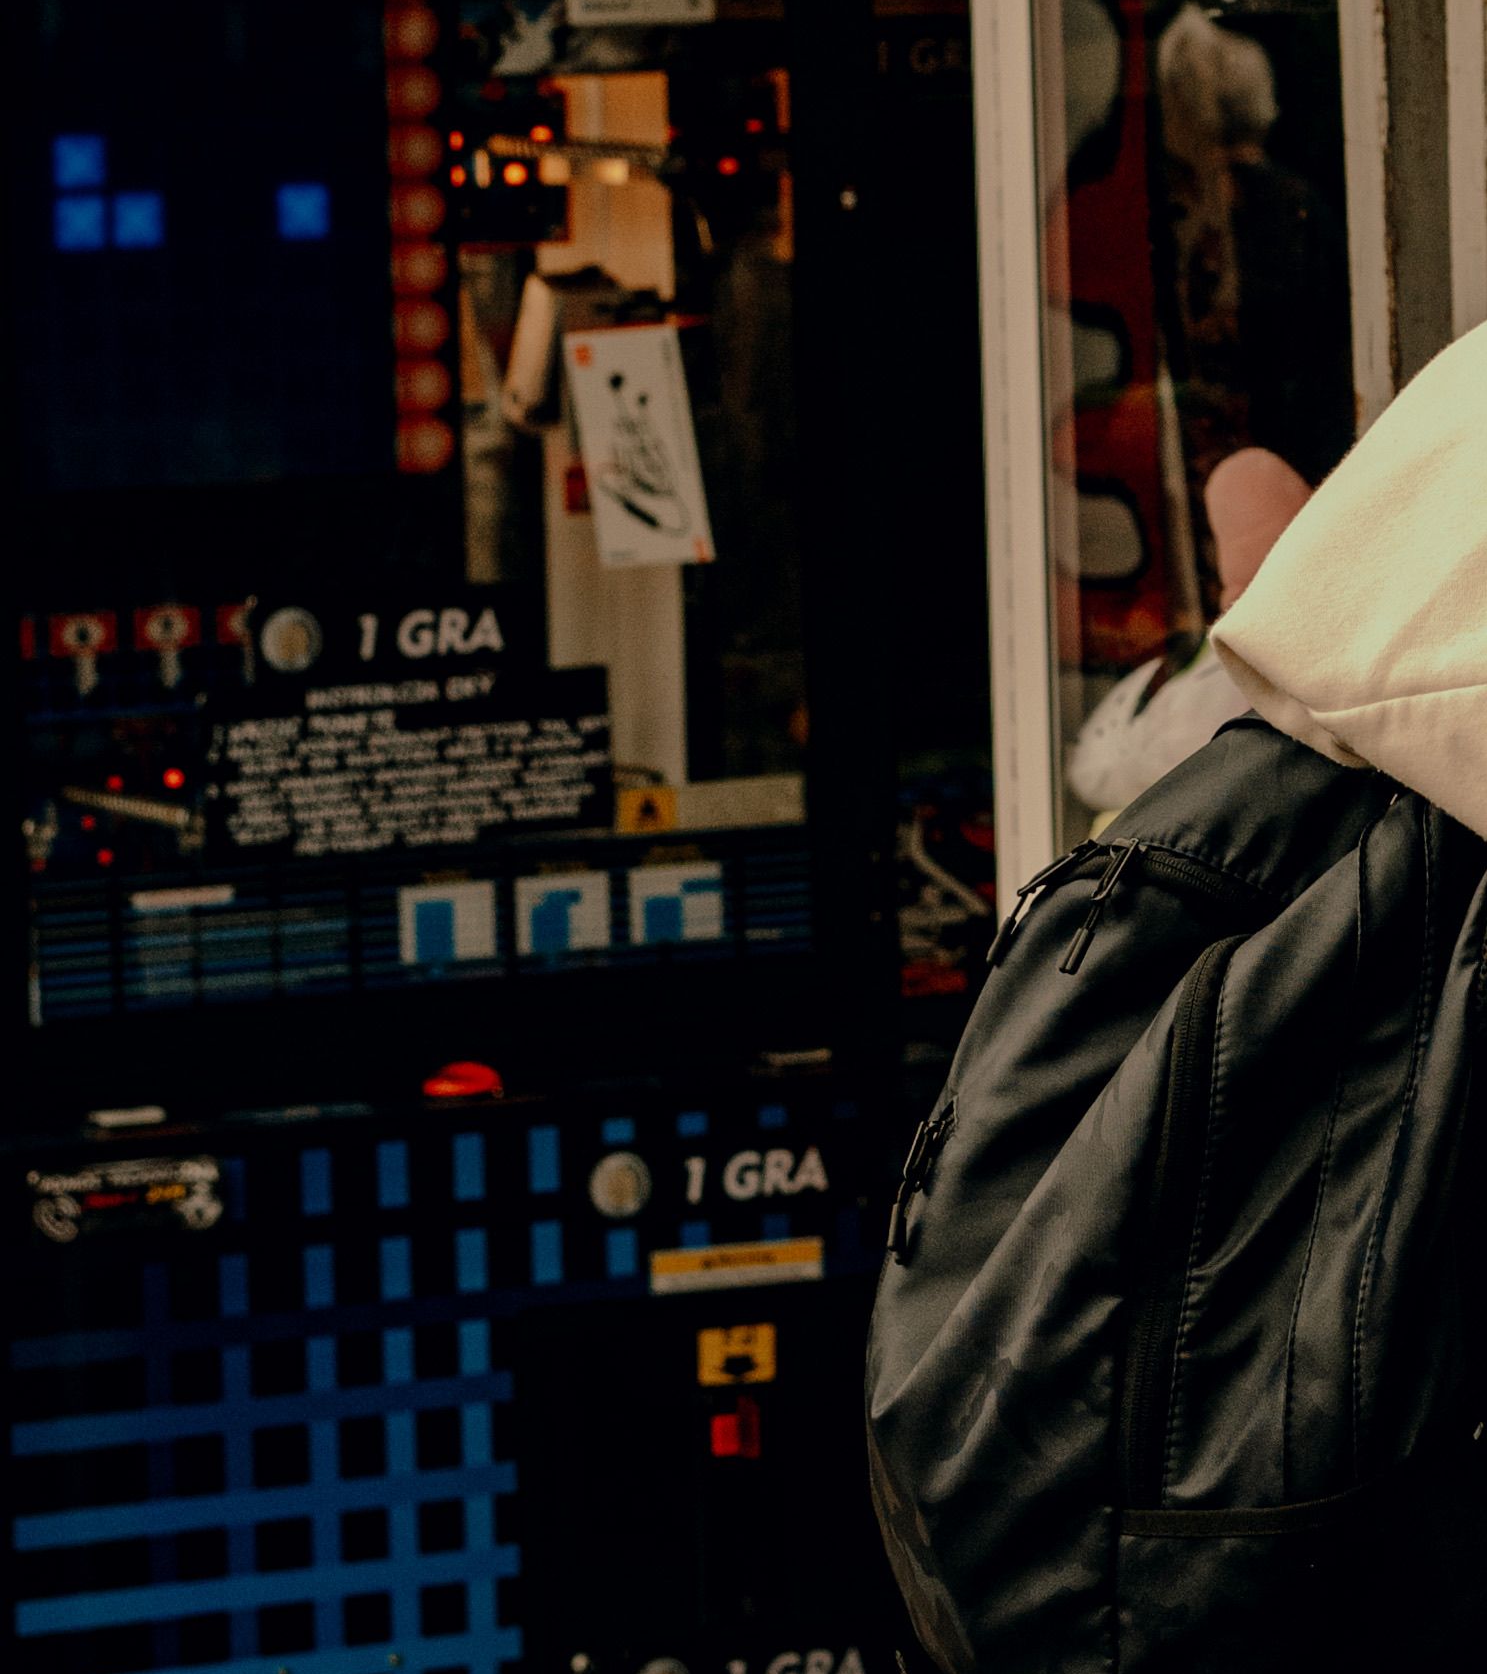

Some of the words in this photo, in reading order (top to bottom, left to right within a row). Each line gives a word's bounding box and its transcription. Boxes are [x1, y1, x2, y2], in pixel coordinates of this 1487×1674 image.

[356, 612, 379, 662] 1
[397, 605, 506, 660] GRA
[684, 1154, 706, 1204] 1
[722, 1146, 830, 1203] GRA
